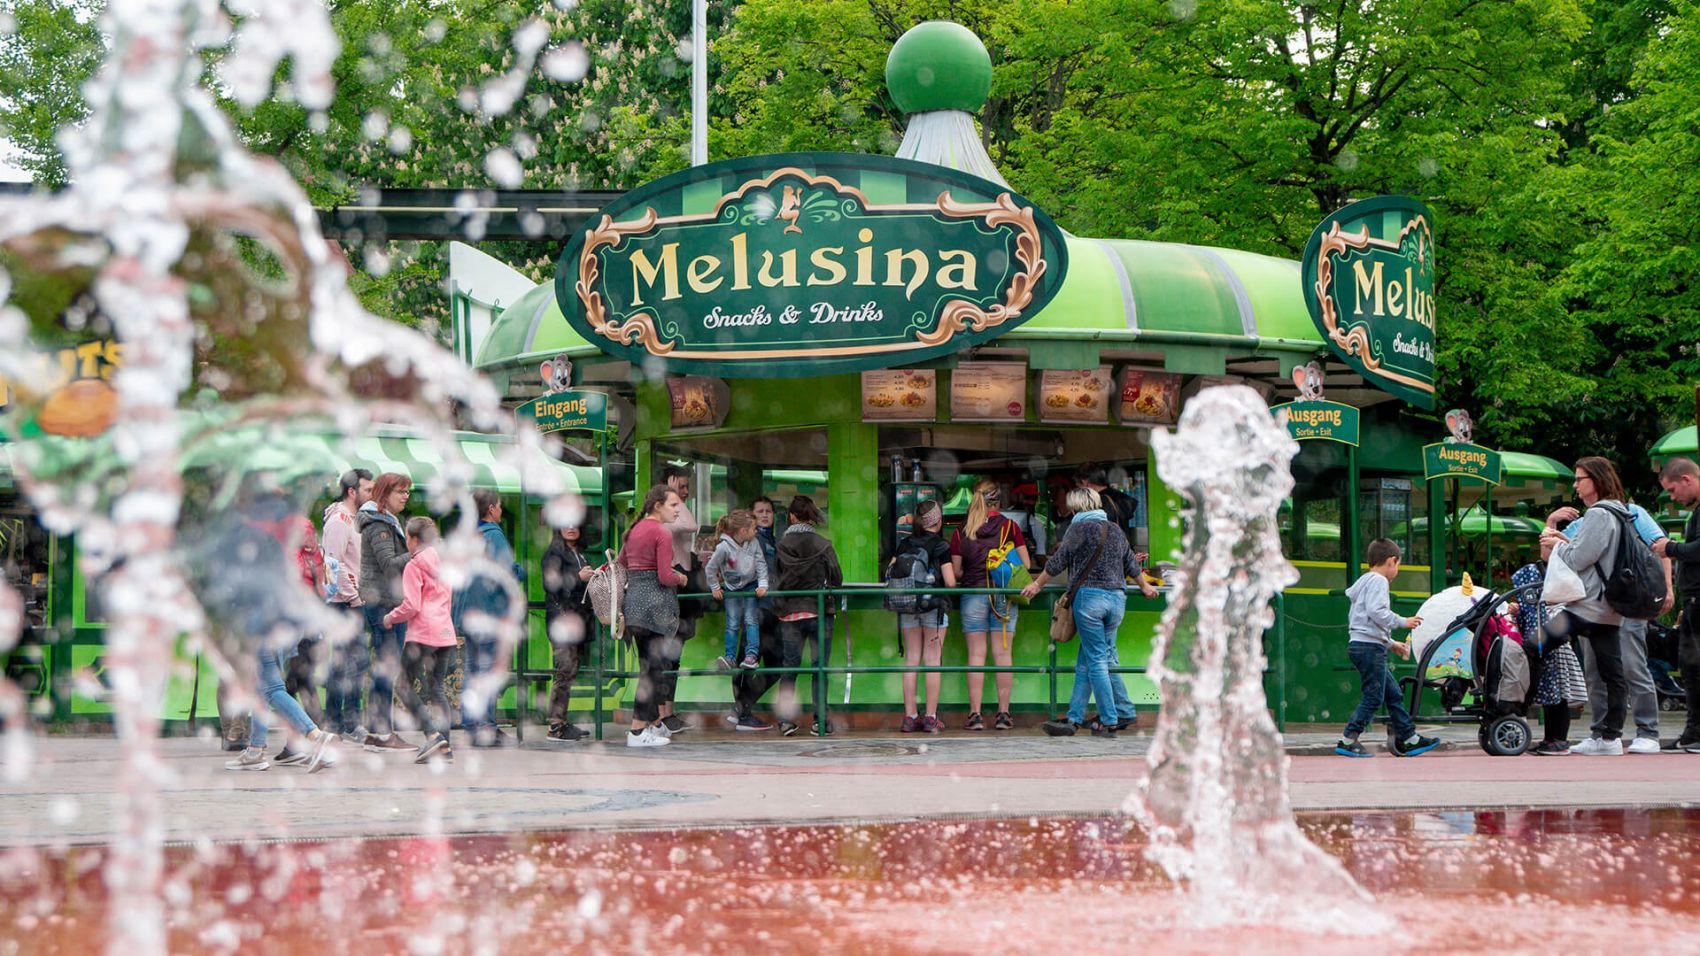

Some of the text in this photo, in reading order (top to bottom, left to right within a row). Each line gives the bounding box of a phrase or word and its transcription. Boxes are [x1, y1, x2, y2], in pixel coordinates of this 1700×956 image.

[629, 227, 978, 306] Melusina
[703, 301, 884, 329] Snacks & Drinks
[535, 399, 587, 418] Eingang
[1286, 406, 1342, 426] Ausgang
[561, 418, 587, 427] Entrance
[1296, 427, 1332, 436] Sortie Exit
[1439, 446, 1487, 467] Ausgang
